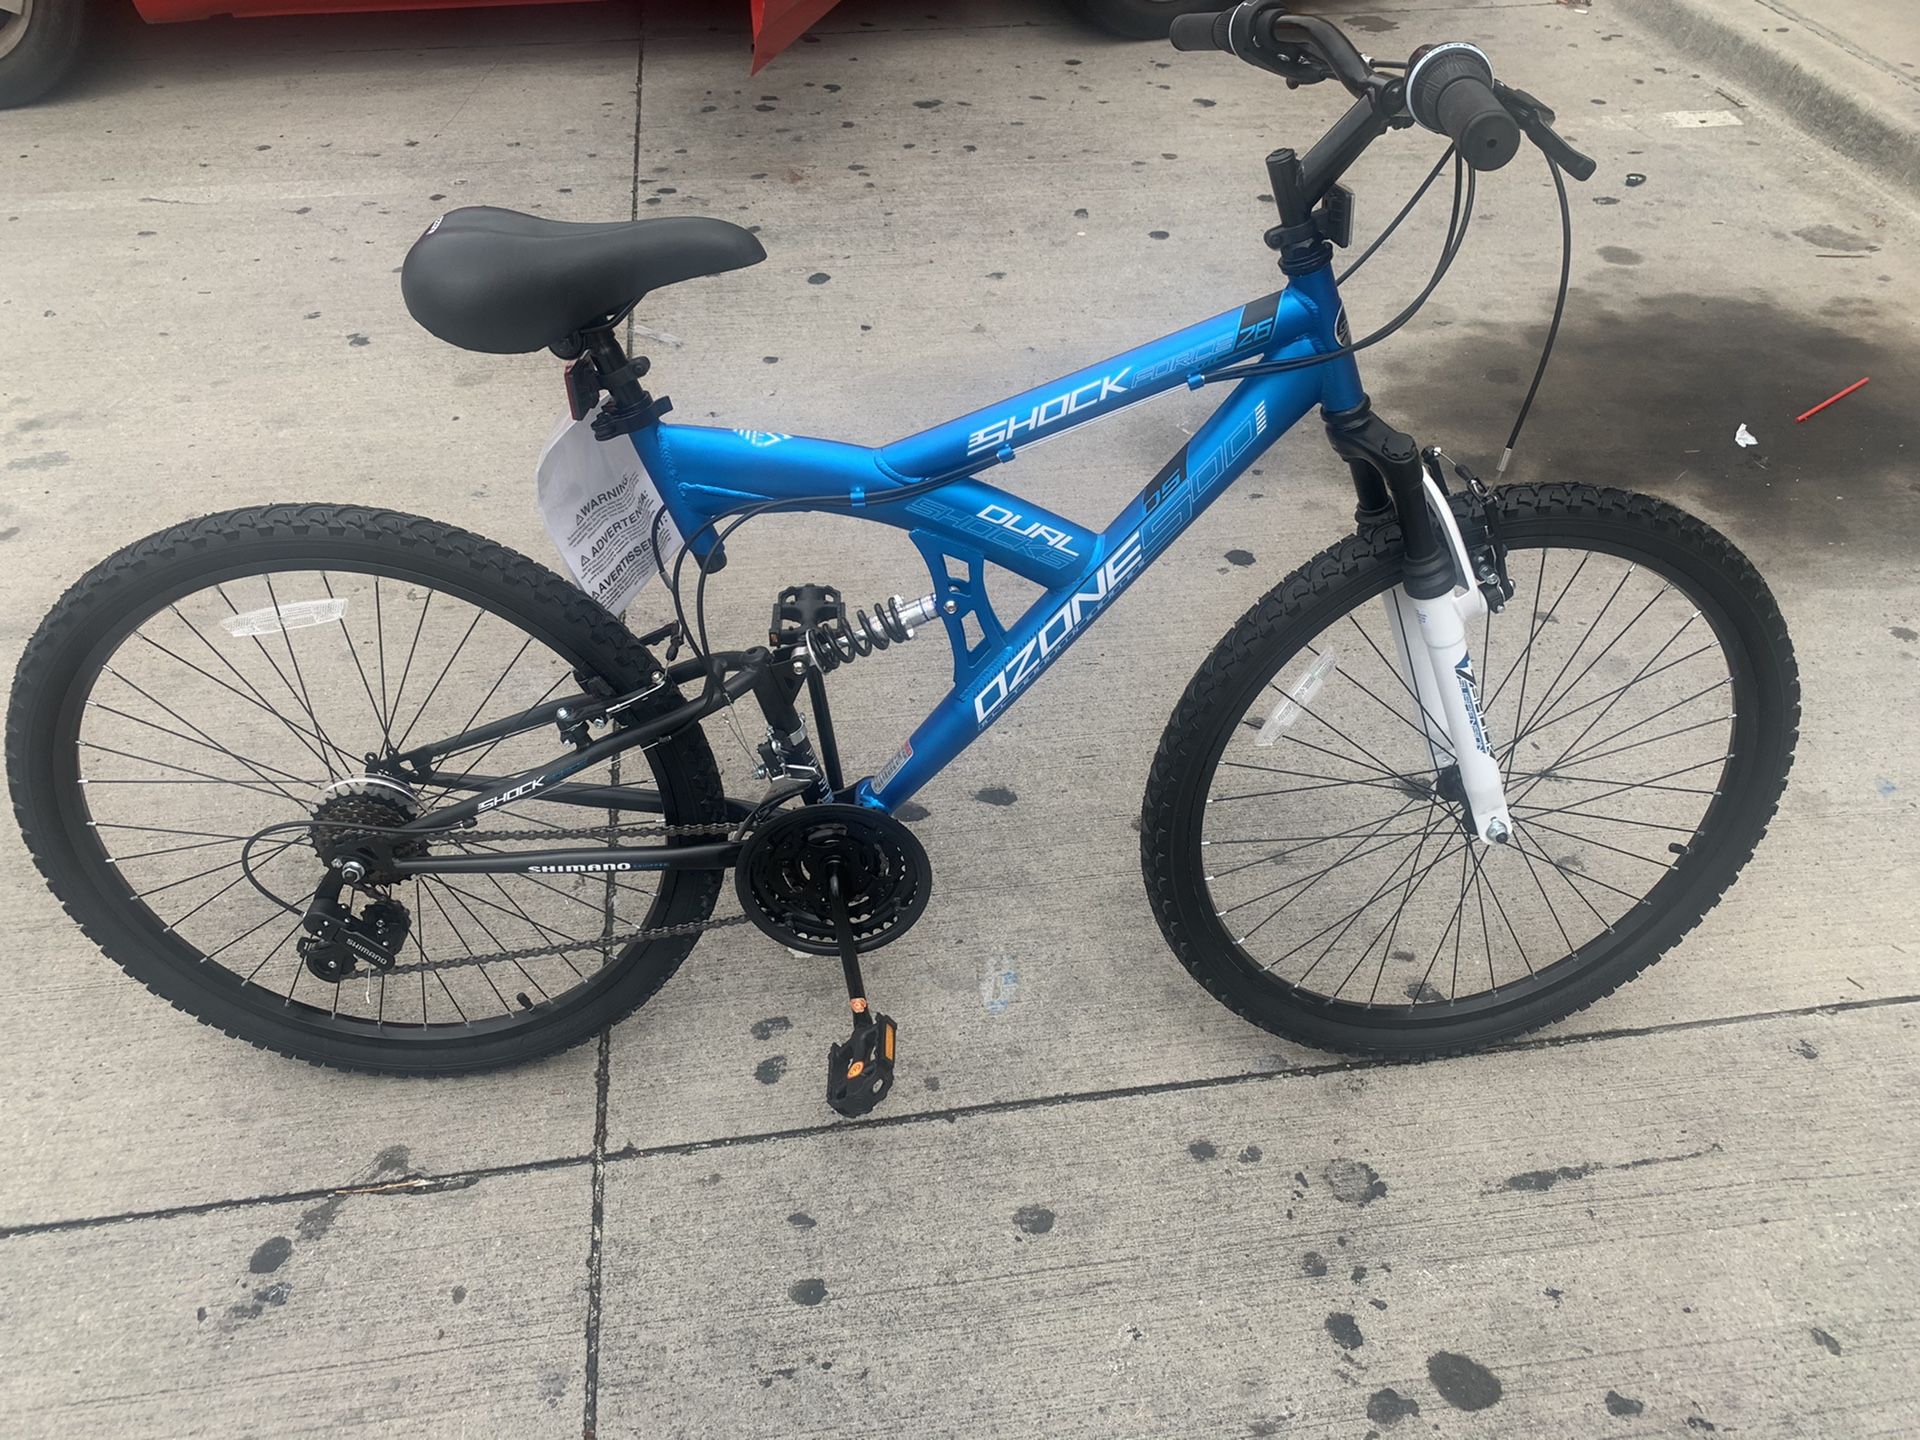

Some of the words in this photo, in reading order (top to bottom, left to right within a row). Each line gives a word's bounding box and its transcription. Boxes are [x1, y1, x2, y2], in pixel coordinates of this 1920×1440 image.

[967, 366, 1131, 456] SHOCK
[1131, 332, 1236, 388] FORCE
[1236, 317, 1273, 348] 26
[905, 498, 1077, 570] SHOCKS
[976, 504, 1079, 557] DUAL
[974, 529, 1142, 724] OZONE
[477, 775, 545, 813] SHOCK
[527, 861, 632, 873] SHIMANO
[346, 938, 387, 965] SHIMANO
